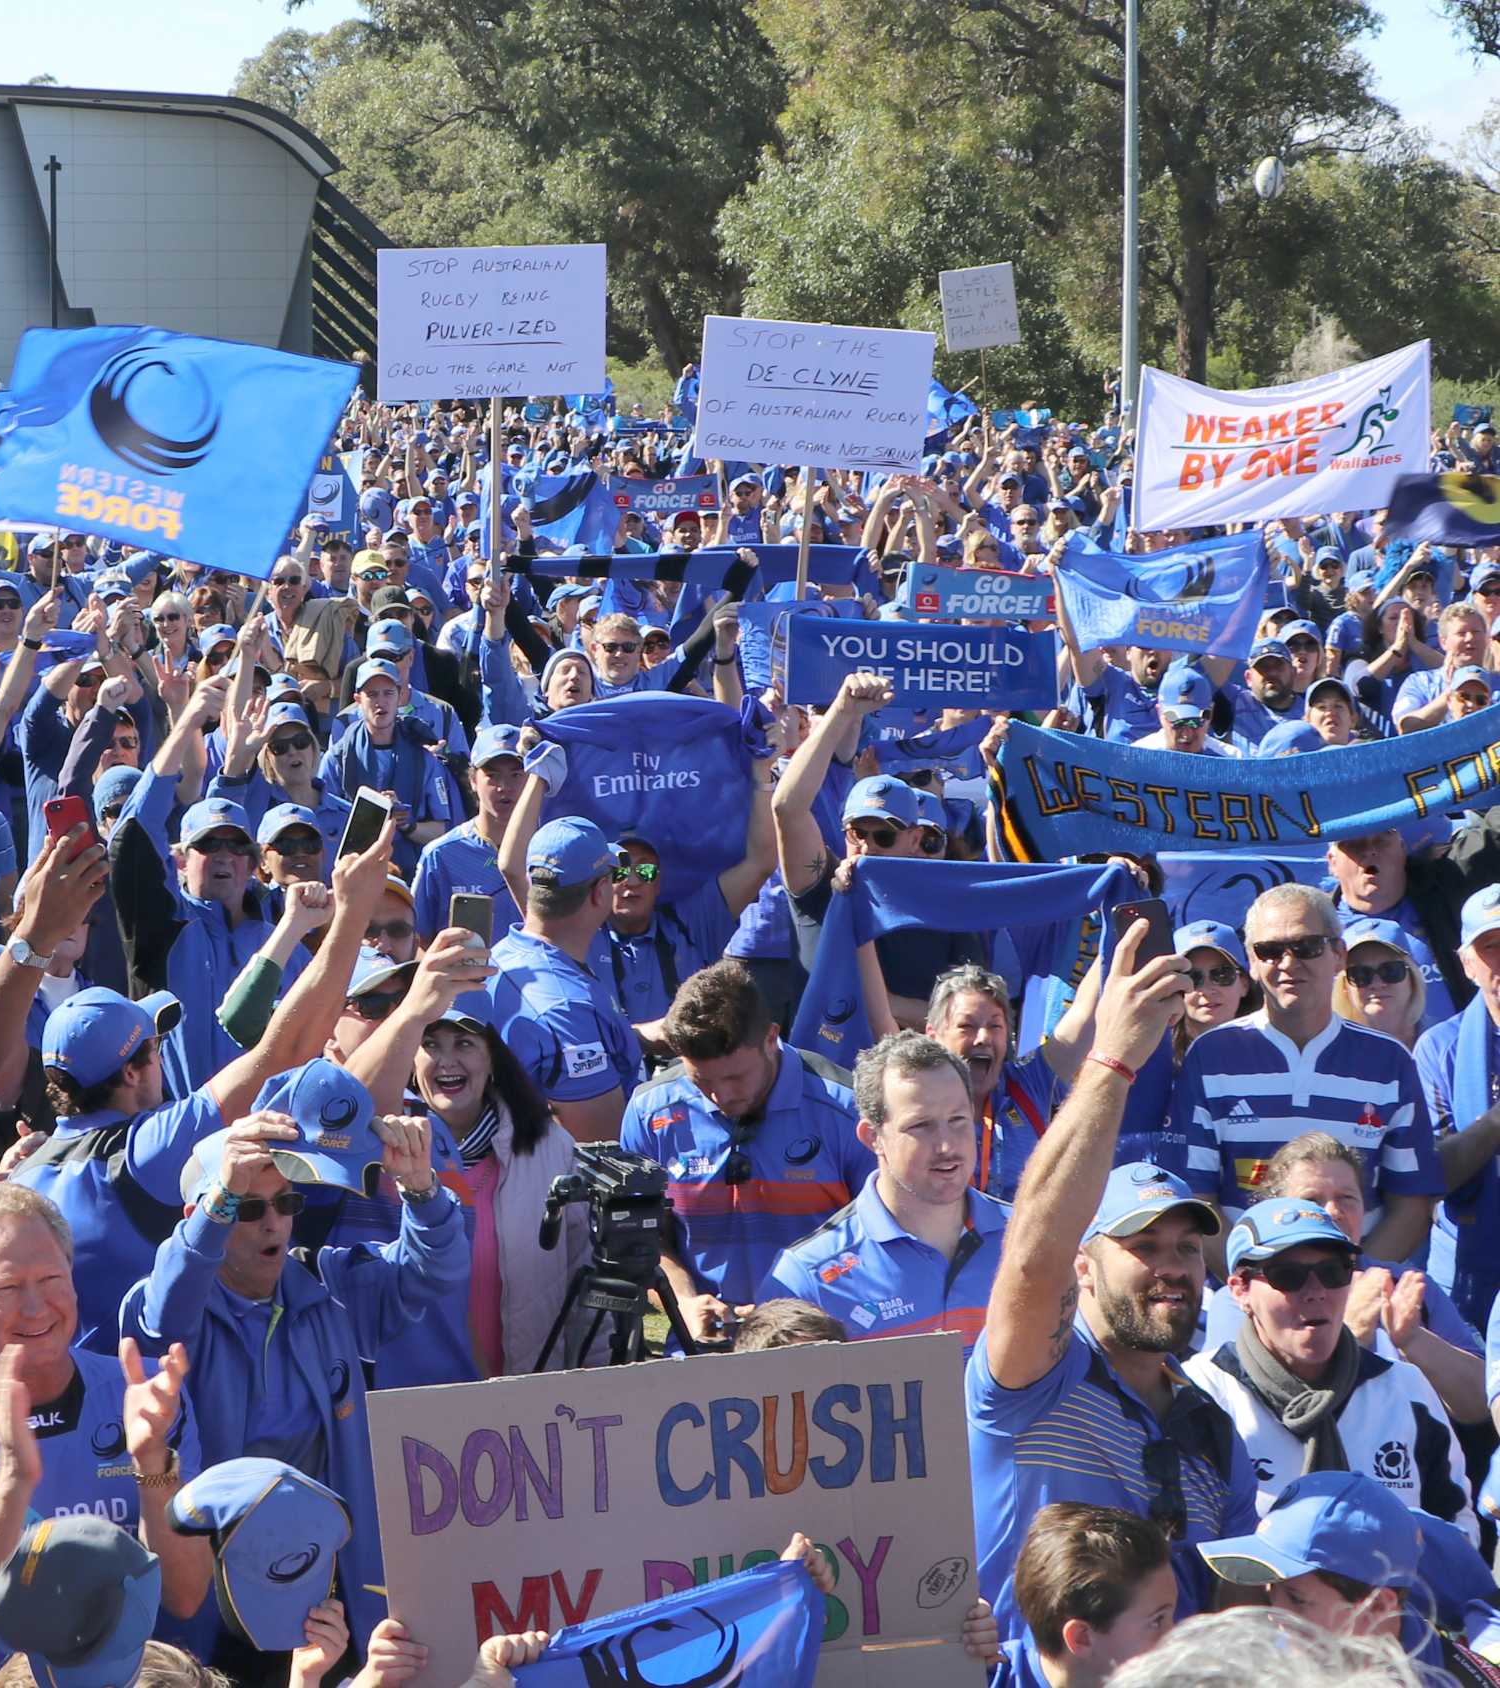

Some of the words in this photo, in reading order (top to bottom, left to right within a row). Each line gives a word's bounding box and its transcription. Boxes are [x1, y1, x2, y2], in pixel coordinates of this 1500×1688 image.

[407, 258, 459, 277] STOP
[472, 259, 570, 273] AUSTRALIAN
[421, 292, 478, 307] RUGBY
[501, 290, 550, 306] BEING
[426, 320, 556, 341] PULVER-IZED
[726, 326, 805, 350] STOP
[832, 339, 884, 358] THE
[388, 363, 438, 378] GROW
[448, 364, 476, 375] THE
[487, 362, 528, 373] GAME
[546, 362, 578, 373] NOT
[747, 363, 881, 390] DE-CLYNE
[705, 399, 738, 414] OF
[748, 402, 852, 420] AUSTRALIAN
[866, 407, 919, 426] RUGBY
[1184, 401, 1346, 444] WEAKER
[705, 433, 755, 448] GROW
[760, 438, 788, 450] THE
[795, 441, 836, 455] GAME
[841, 443, 868, 457] NOT
[1179, 453, 1235, 491] BY
[1239, 436, 1321, 481] ONE
[1330, 453, 1403, 471] Wallabies
[653, 482, 676, 494] GO
[634, 495, 696, 508] FORCE!
[975, 575, 1011, 594] GO
[947, 595, 1042, 614] FORCE!
[1136, 619, 1210, 643] FORCE
[821, 635, 888, 659] YOU
[896, 639, 1024, 666] SHOULD
[904, 668, 991, 693] HERE!
[633, 752, 660, 771] Fly
[593, 768, 701, 799] Emirates
[1023, 755, 1321, 841] WESTERN
[878, 1297, 904, 1311] ROAD
[881, 1303, 915, 1320] SAFETY
[401, 1404, 622, 1535] DON'T
[655, 1380, 927, 1507] CRUSH
[471, 1569, 604, 1648] MY
